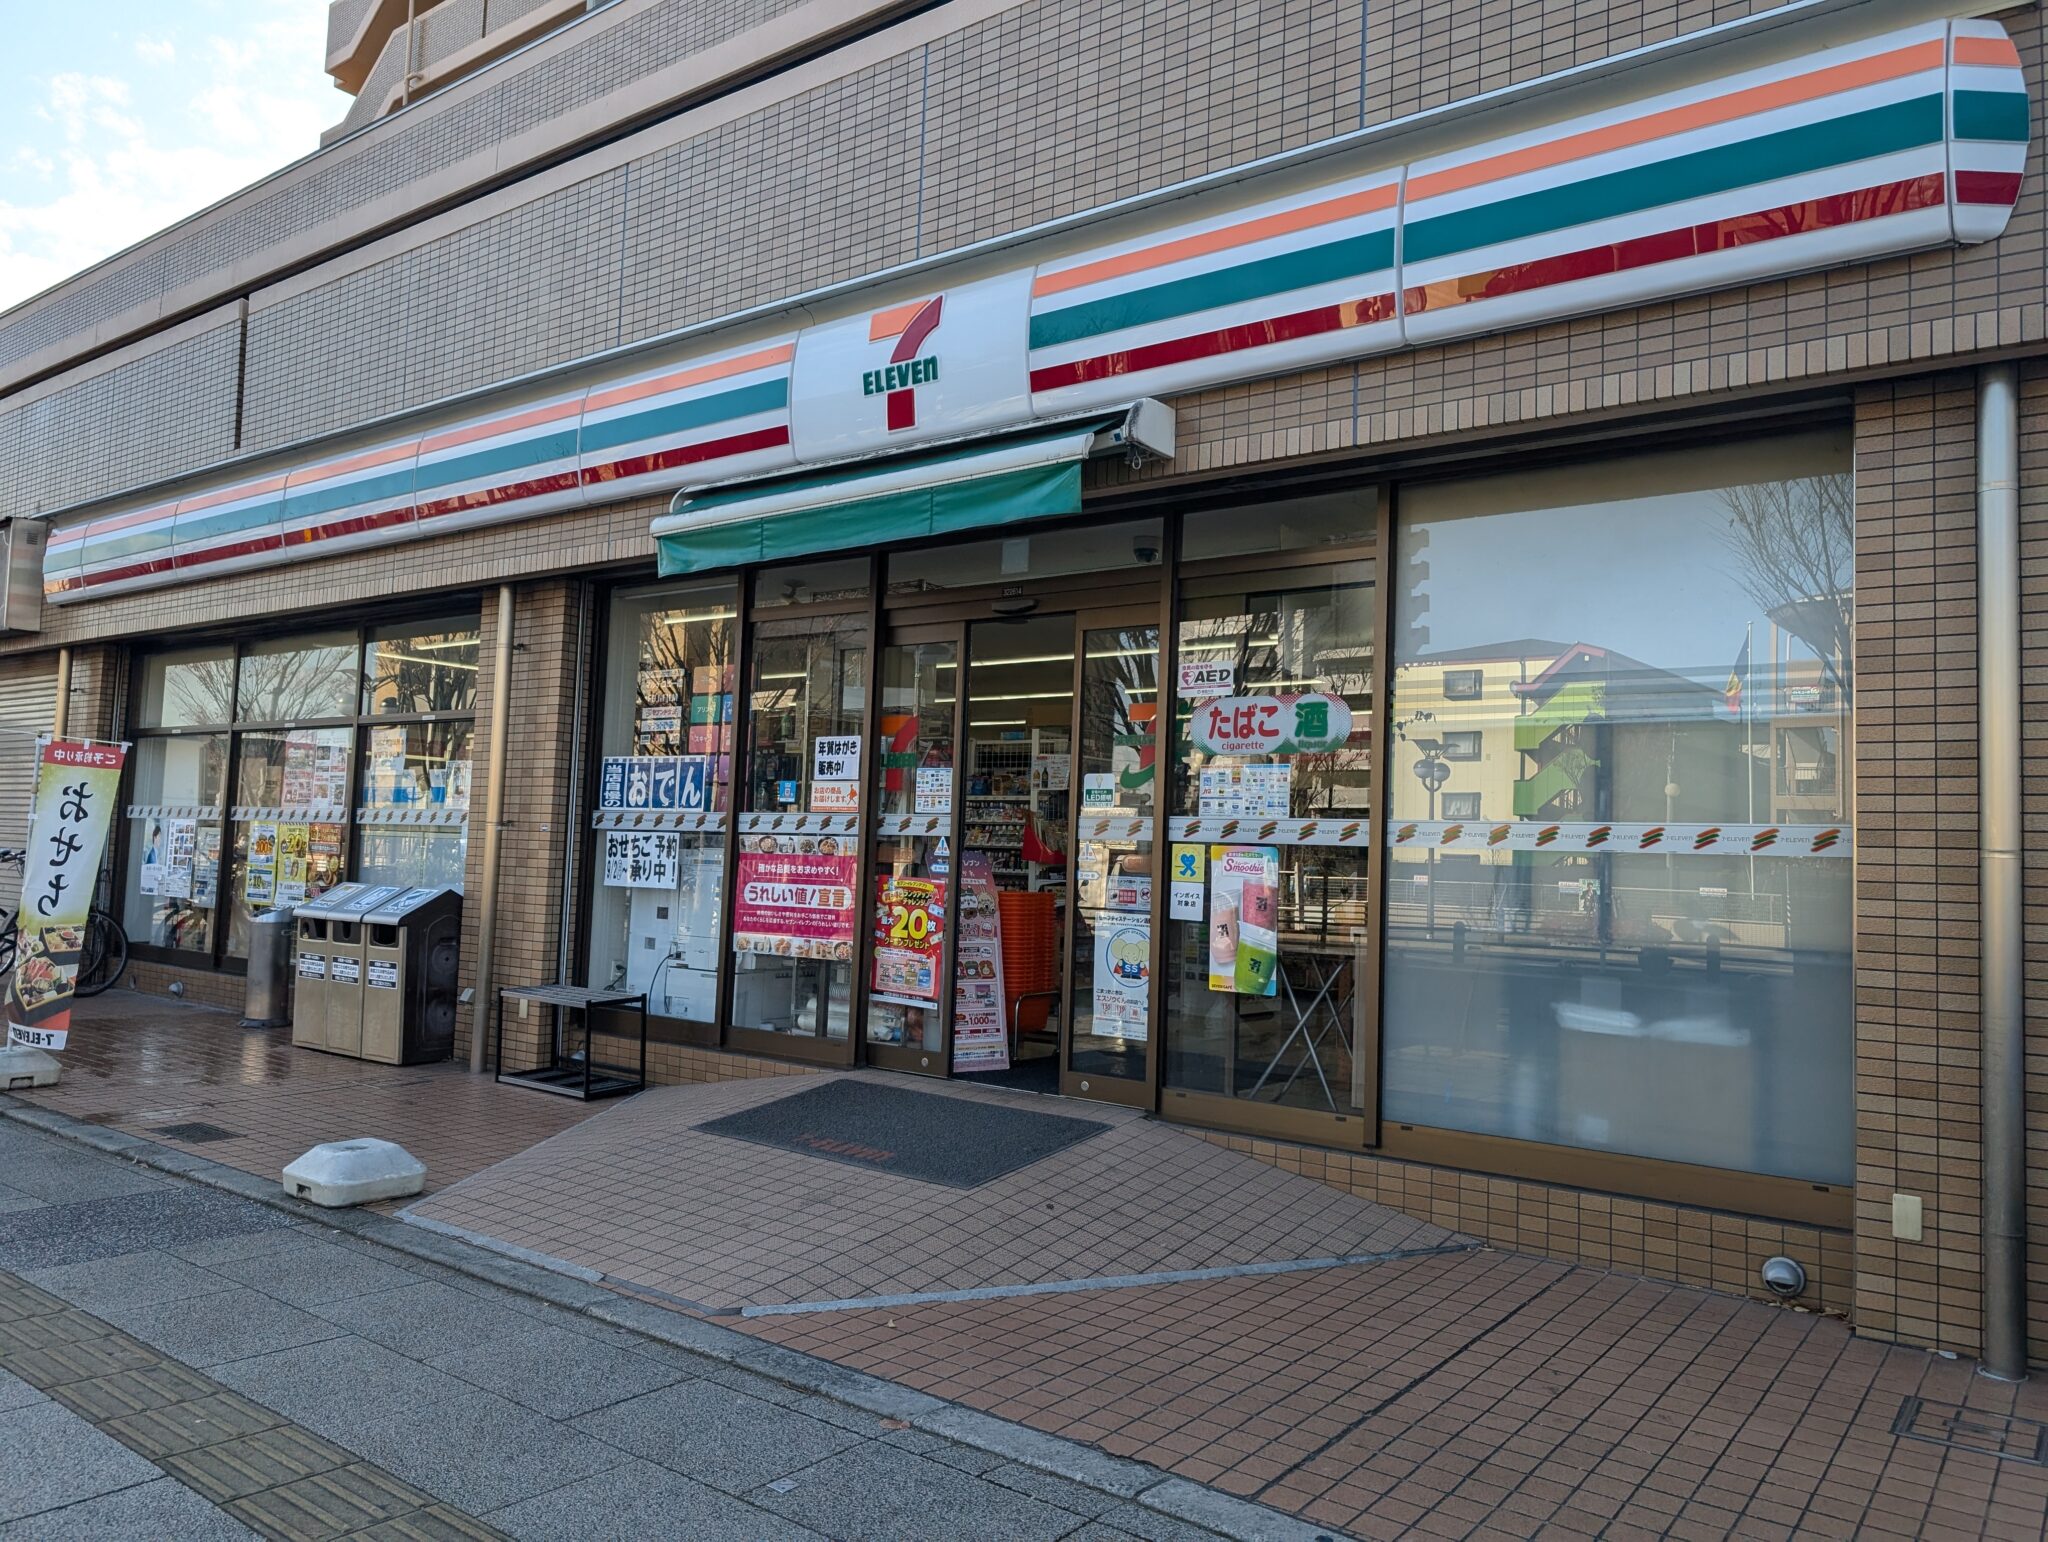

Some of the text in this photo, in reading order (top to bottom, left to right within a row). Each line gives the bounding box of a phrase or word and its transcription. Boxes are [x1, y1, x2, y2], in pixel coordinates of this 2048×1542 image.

[1194, 669, 1231, 683] AED
[1209, 702, 1329, 740] たばこ 酒
[818, 740, 857, 756] 年賀はがき
[1221, 740, 1328, 751] cigarette liquor
[818, 760, 845, 776] 販売中!
[604, 764, 626, 807] 当店自慢の
[628, 764, 701, 808] おでん
[1224, 858, 1265, 874] Smoothie
[748, 885, 846, 908] うれしい値!宣言
[890, 905, 929, 940] 20
[927, 920, 937, 932] 枚
[1124, 964, 1138, 973] SS
